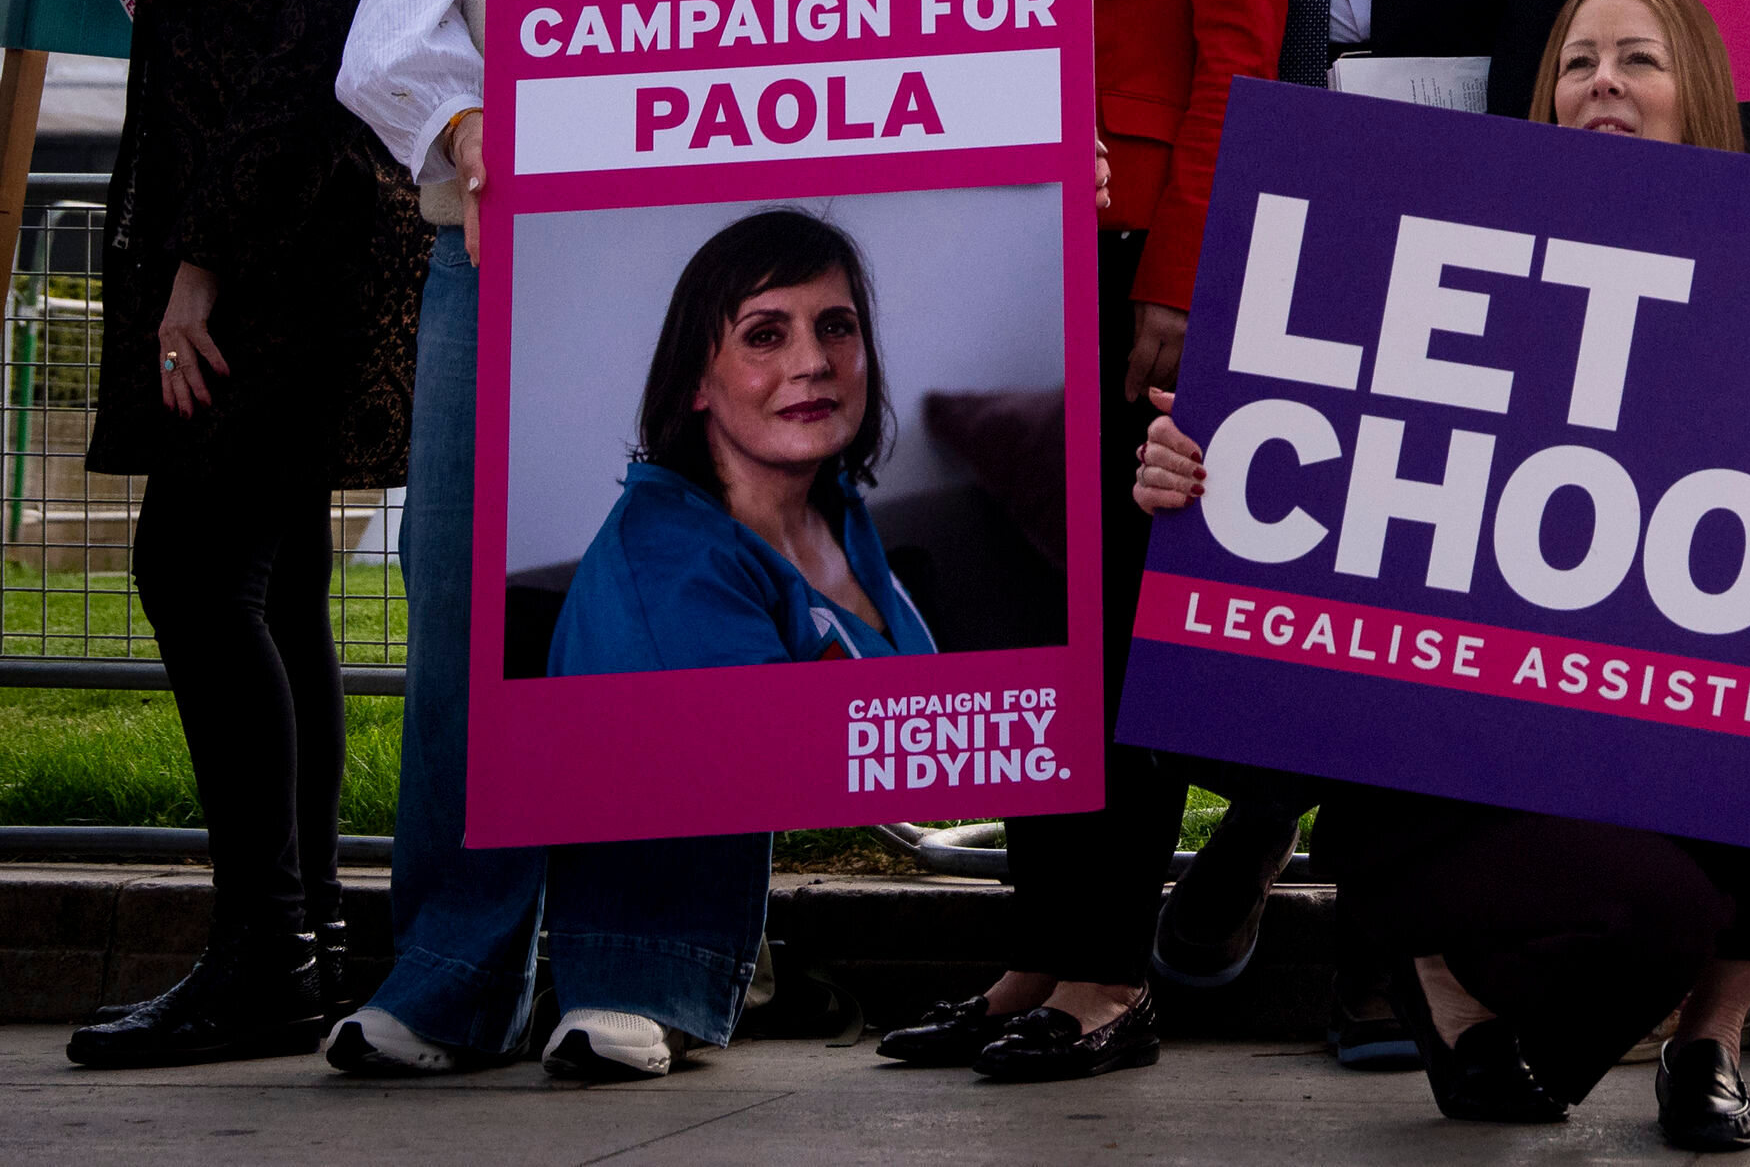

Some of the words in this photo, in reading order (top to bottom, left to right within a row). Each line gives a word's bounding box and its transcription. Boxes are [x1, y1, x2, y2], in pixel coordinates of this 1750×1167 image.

[635, 71, 945, 153] PAOLA
[1228, 192, 1696, 432] LET
[1185, 592, 1485, 678] LEGALISE
[848, 691, 992, 719] CAMPAIGN
[1003, 688, 1057, 710] FOR
[848, 709, 1057, 756] DIGNITY
[848, 756, 896, 792] IN
[906, 747, 1071, 789] DYING.
